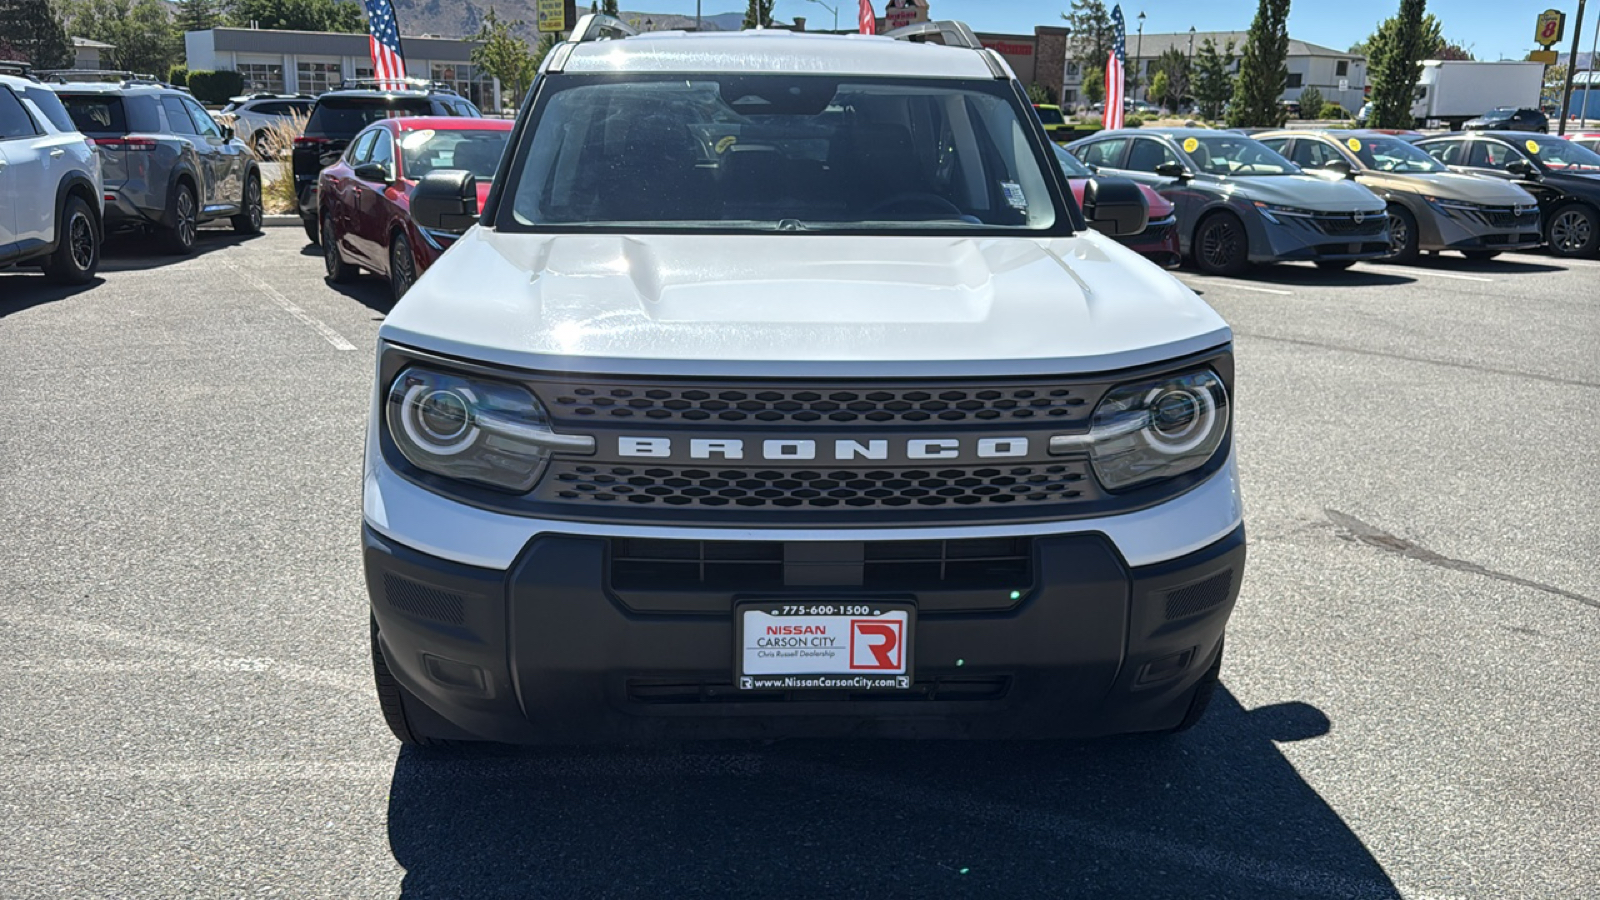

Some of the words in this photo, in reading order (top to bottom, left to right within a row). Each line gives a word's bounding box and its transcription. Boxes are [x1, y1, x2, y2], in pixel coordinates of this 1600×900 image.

[1541, 21, 1556, 38] 8
[618, 436, 1029, 460] BRONCO
[782, 605, 870, 615] 775-600-1500
[766, 625, 826, 635] NISSAN
[757, 637, 807, 647] CARSON
[811, 637, 836, 647] CITY
[856, 624, 897, 667] R
[757, 650, 775, 658] Chris
[777, 650, 798, 658] Russell
[800, 650, 836, 659] Dealership
[754, 677, 896, 689] www.NissanCarsonCity.com
